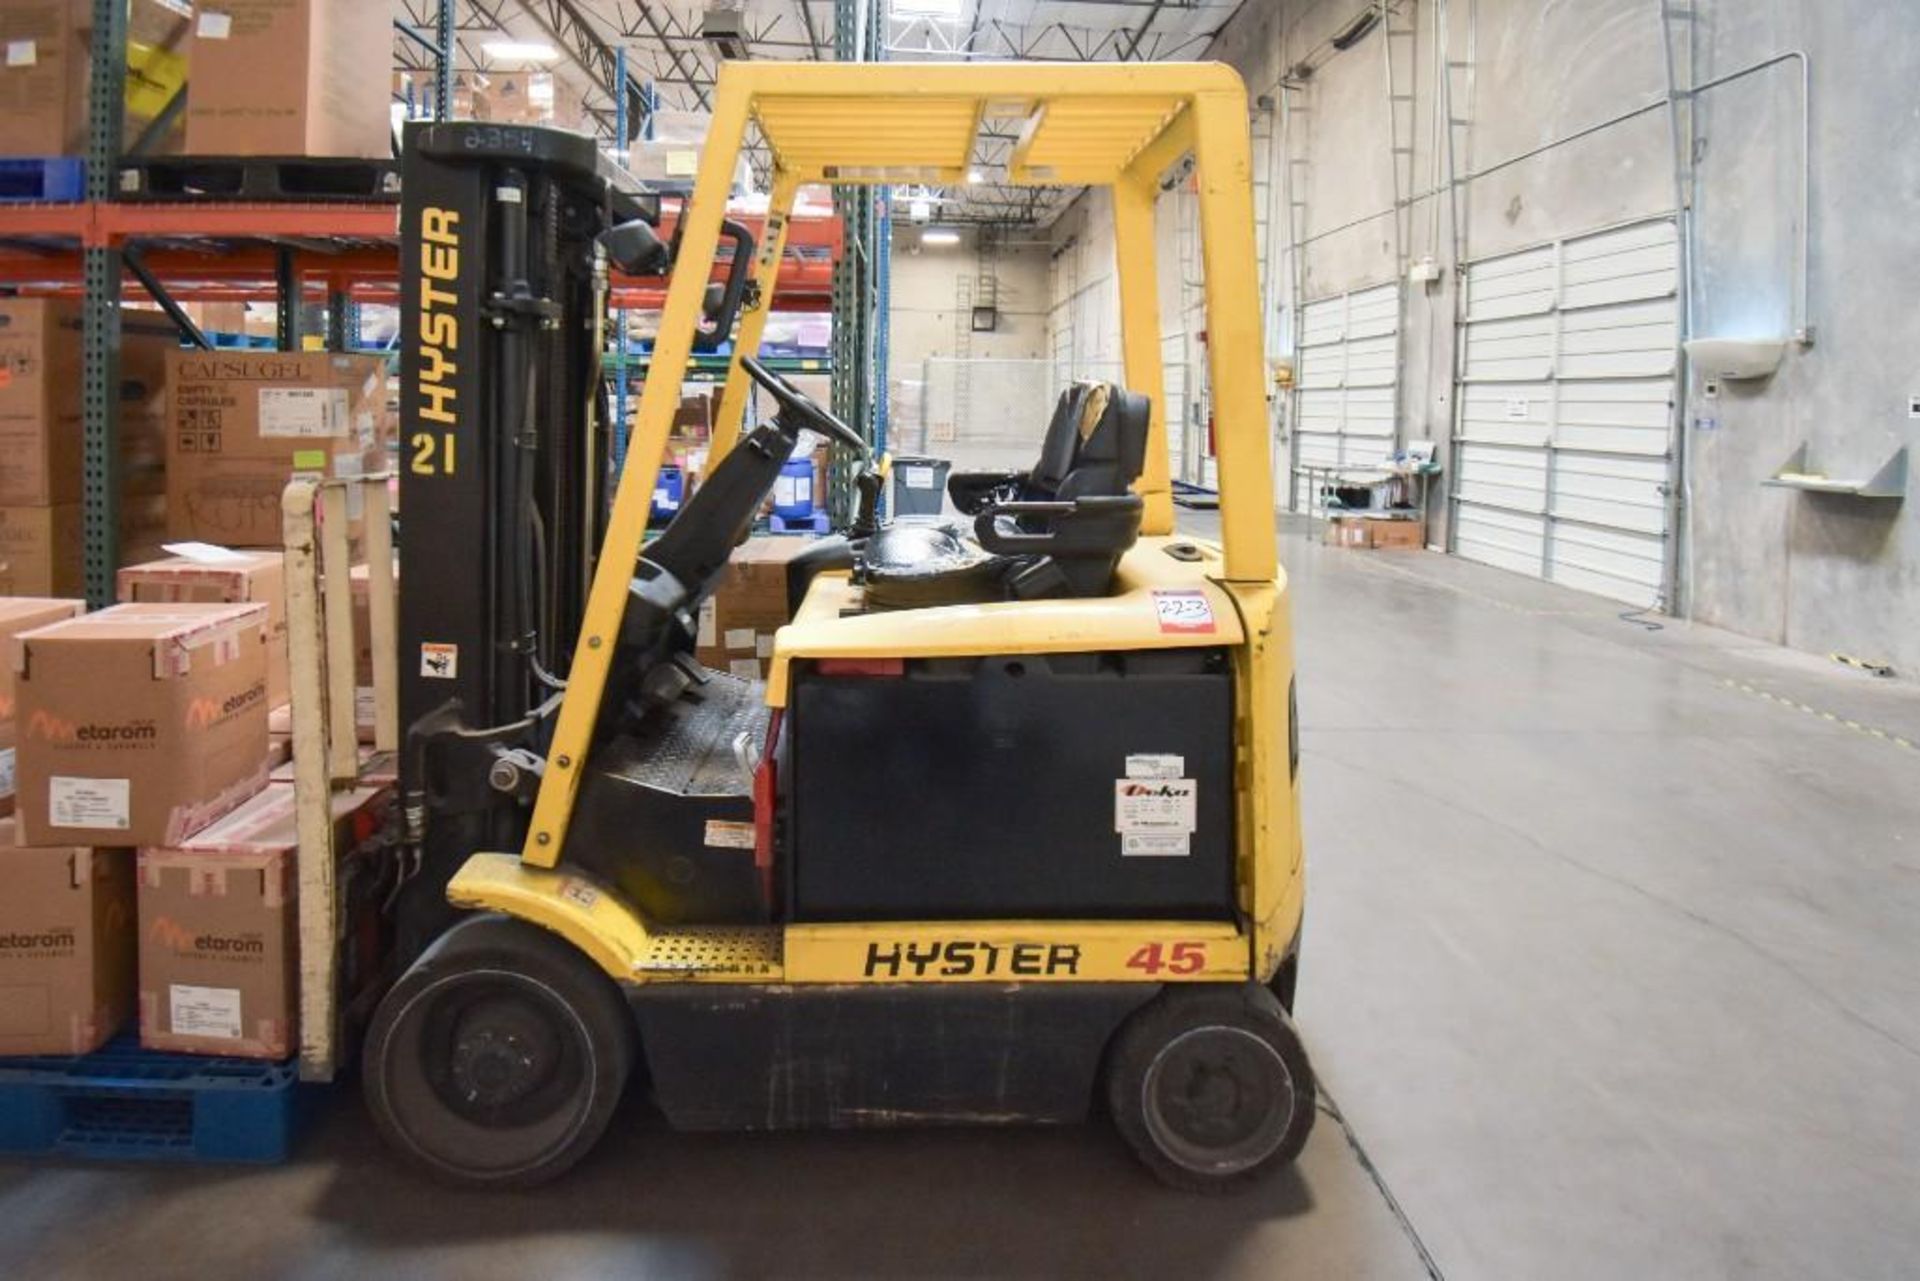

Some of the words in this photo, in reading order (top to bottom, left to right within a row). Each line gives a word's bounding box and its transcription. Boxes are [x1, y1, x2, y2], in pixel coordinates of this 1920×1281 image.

[419, 206, 459, 424] HYSTER
[411, 433, 455, 474] 21
[864, 942, 1081, 976] HYSTER
[1126, 942, 1206, 974] 45
